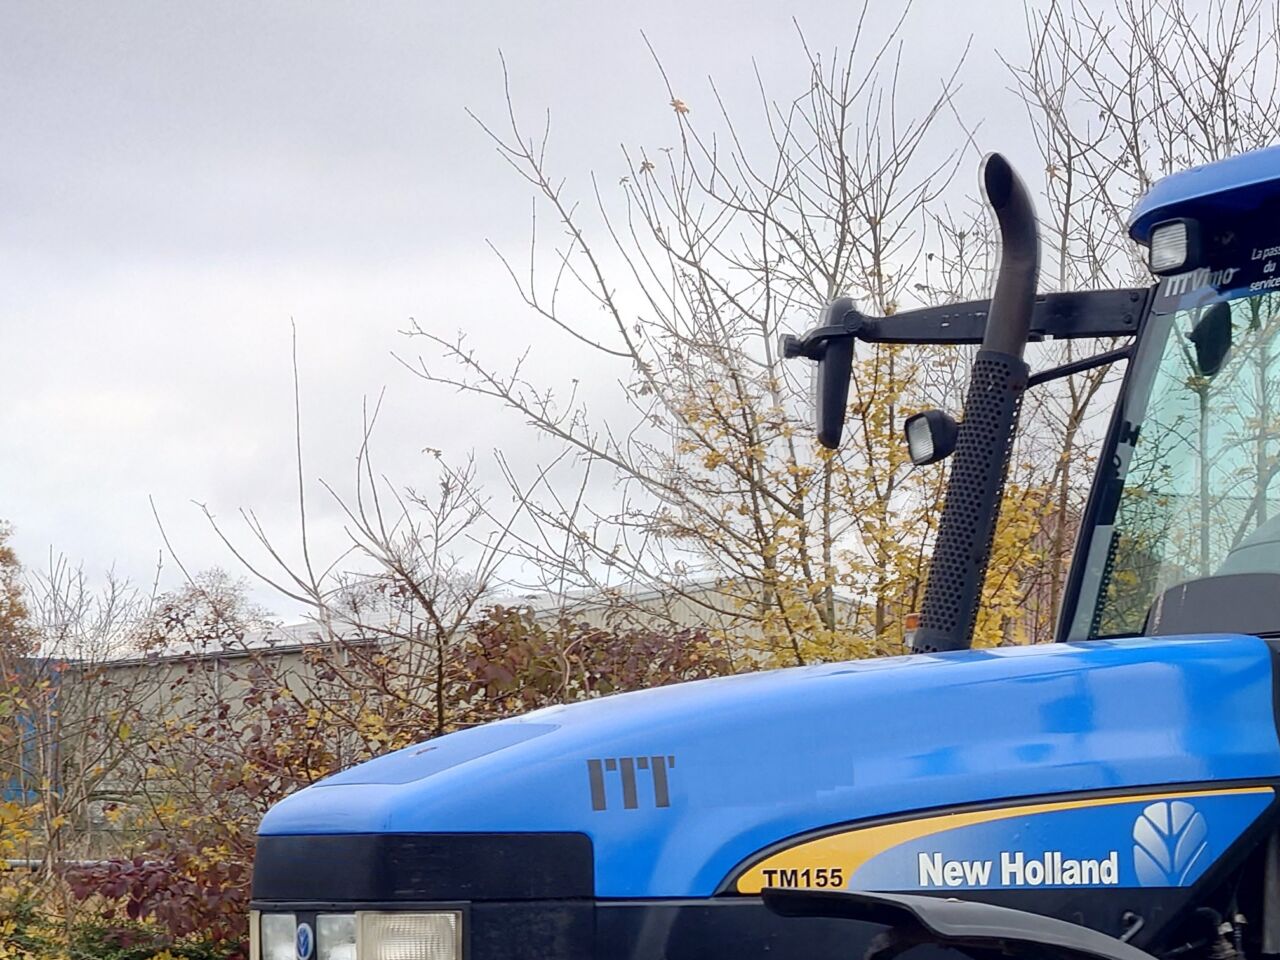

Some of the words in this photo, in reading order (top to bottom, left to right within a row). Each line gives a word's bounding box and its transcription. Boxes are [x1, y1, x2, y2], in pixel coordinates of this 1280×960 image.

[1251, 248, 1263, 260] La
[1263, 260, 1277, 273] du
[918, 852, 992, 887] New
[1001, 851, 1119, 886] Holland
[762, 868, 843, 888] TM155
